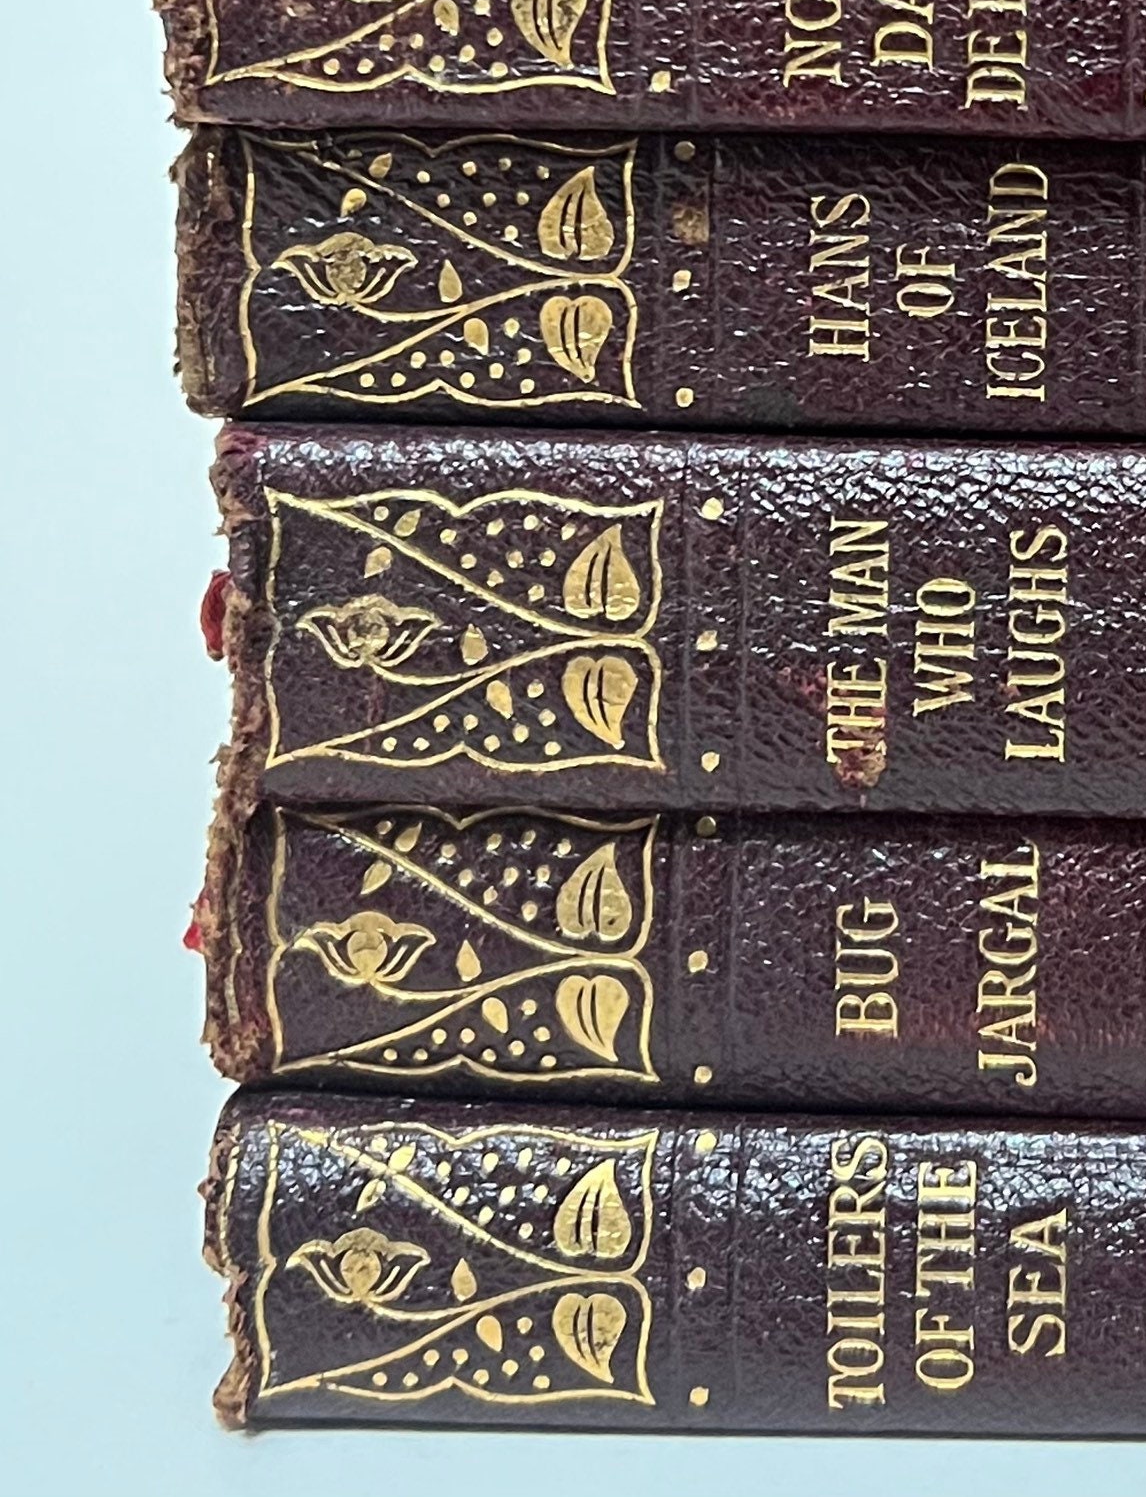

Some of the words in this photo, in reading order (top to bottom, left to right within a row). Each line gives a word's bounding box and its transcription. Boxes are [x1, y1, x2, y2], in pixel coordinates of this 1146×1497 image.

[965, 28, 1030, 111] DE
[809, 191, 872, 363] HANS
[897, 242, 956, 319] OF
[986, 161, 1050, 403] ICELAND
[828, 515, 889, 637] MAN
[914, 575, 977, 716] WHO
[1005, 524, 1069, 764] LAUGHS
[826, 657, 887, 764] THE
[835, 896, 900, 1040] BUG
[978, 840, 1041, 1087] JARGAL
[828, 1133, 889, 1410] TOILERS
[916, 1158, 978, 1291] THE
[1007, 1206, 1067, 1357] SEA
[916, 1299, 974, 1393] OF
